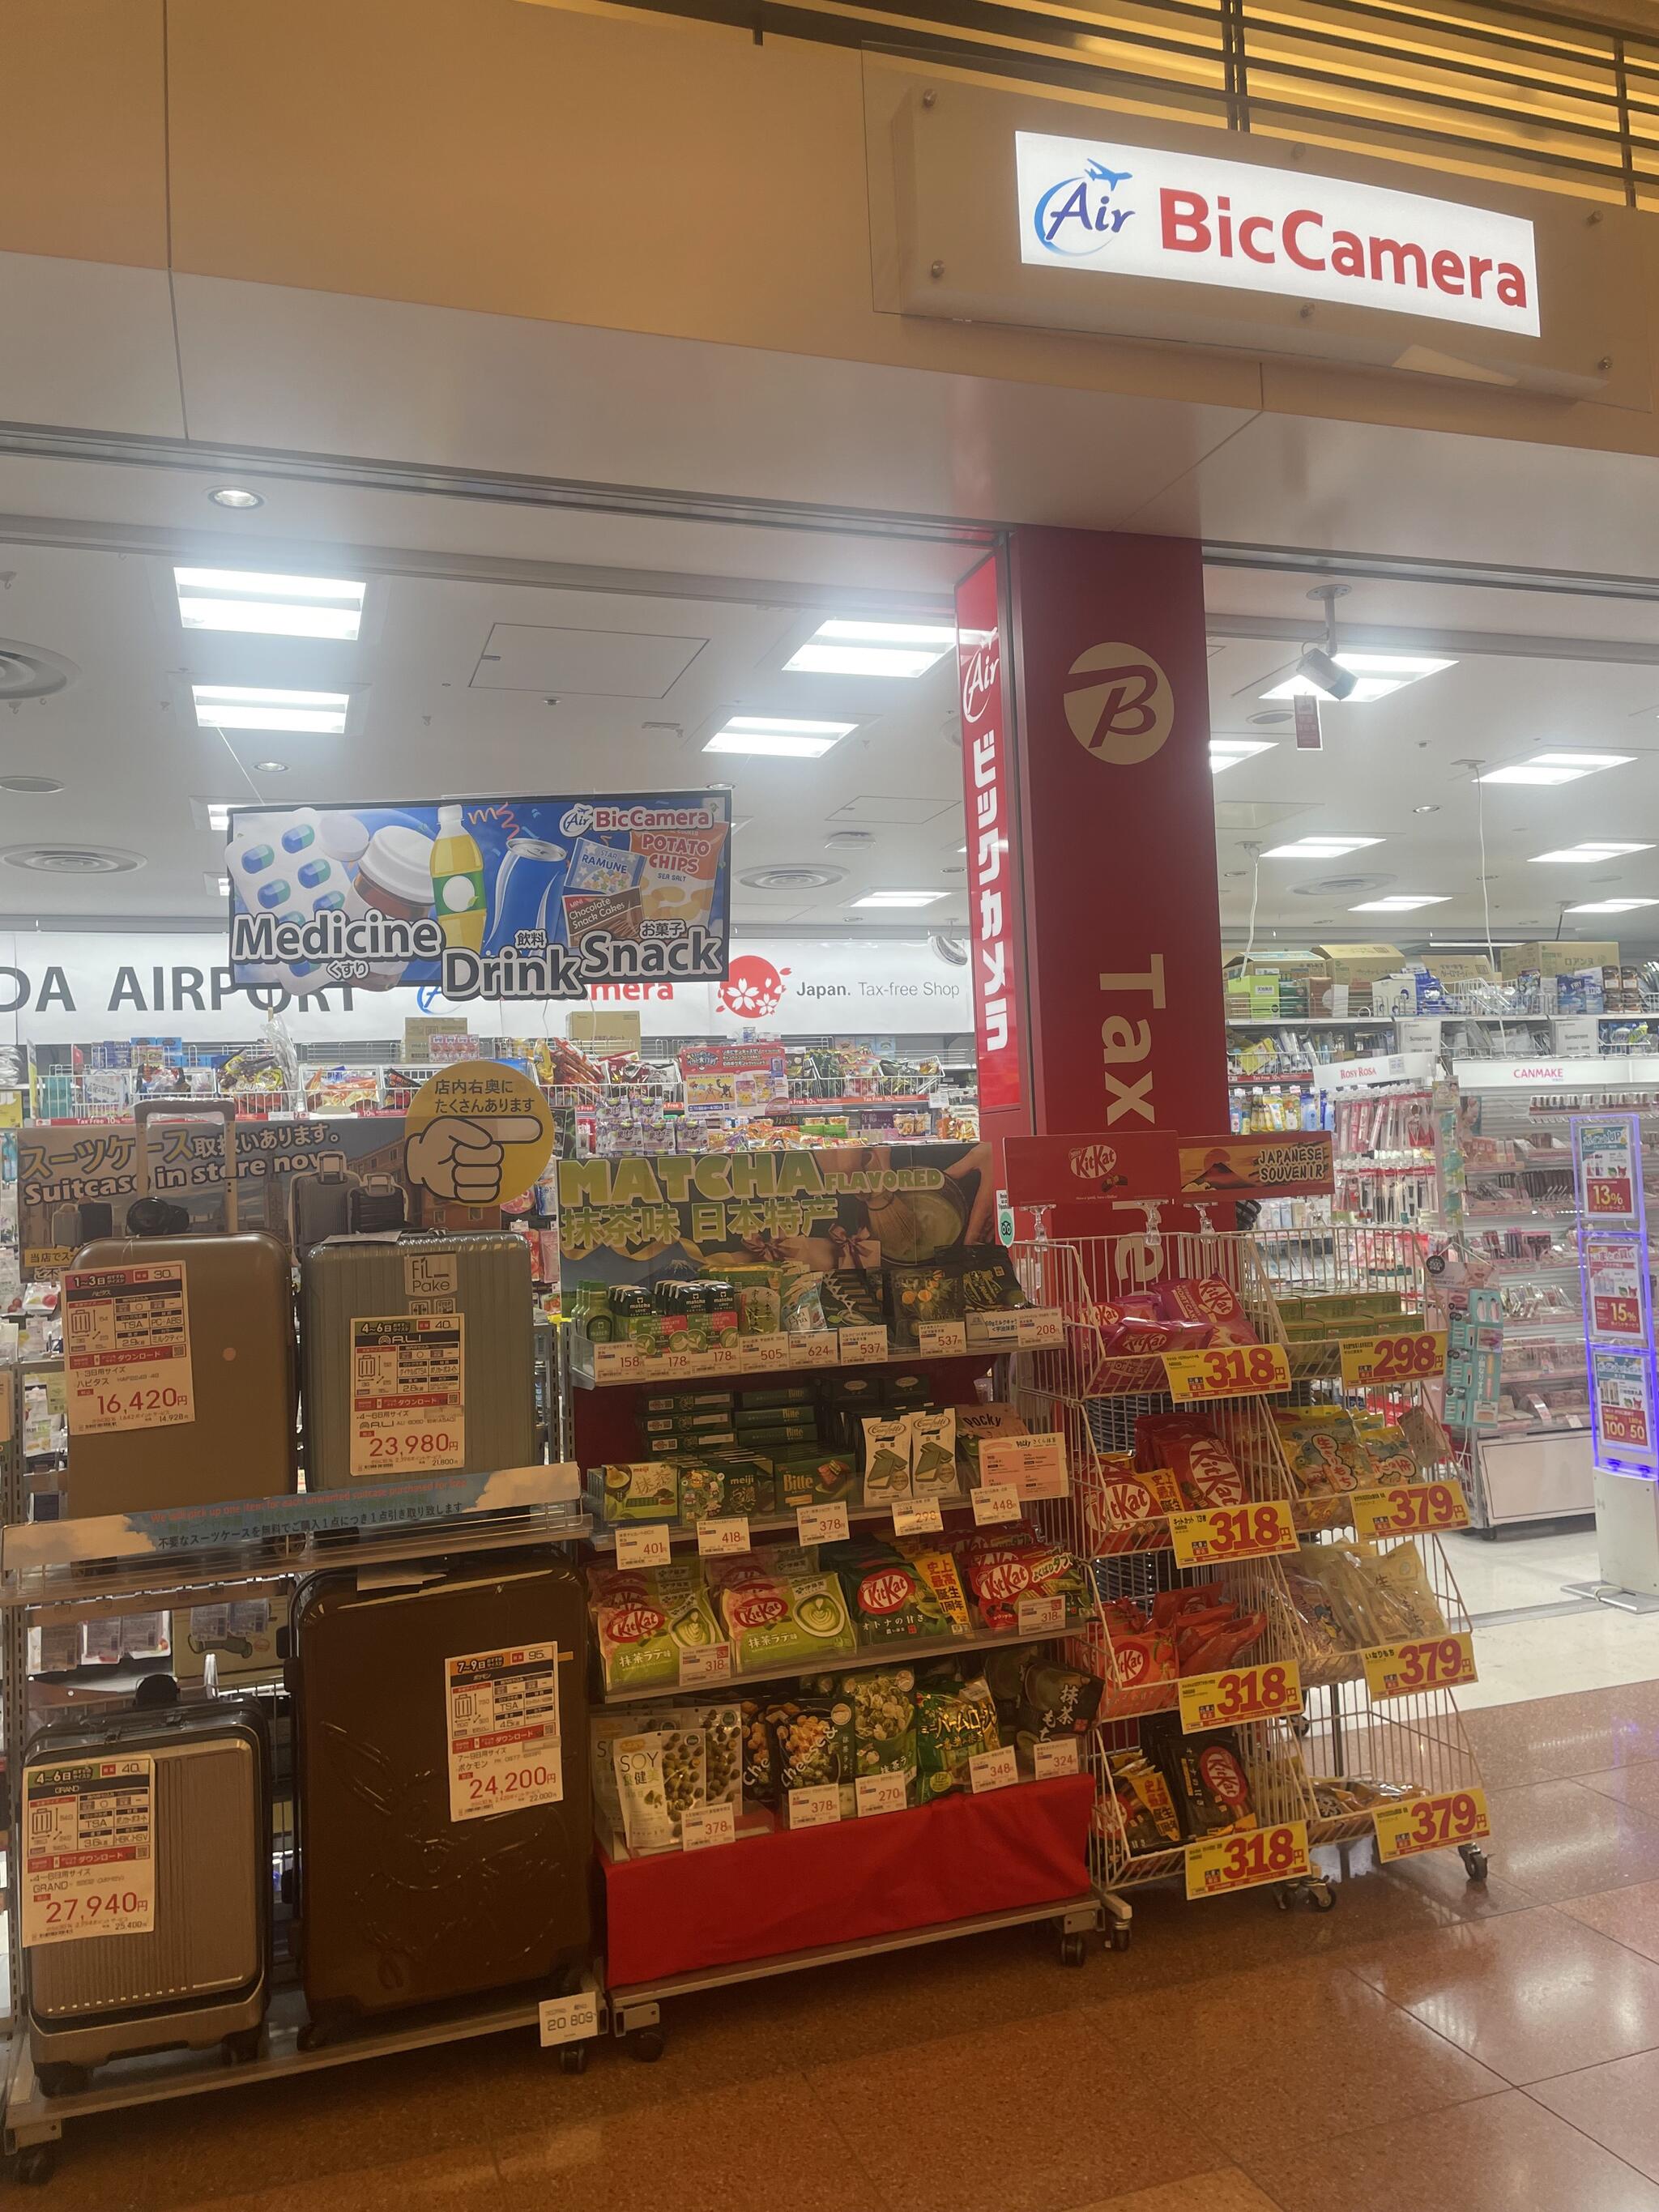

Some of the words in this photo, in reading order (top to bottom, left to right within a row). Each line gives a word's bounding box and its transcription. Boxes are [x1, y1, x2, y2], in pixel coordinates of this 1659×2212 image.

[1044, 182, 1136, 242] Air
[1160, 187, 1528, 309] BicCamera
[567, 812, 589, 829] Air
[596, 810, 709, 828] BicCamera
[600, 850, 617, 859] STAR
[642, 834, 710, 855] POTATO
[582, 854, 627, 874] RAMUNE
[649, 854, 699, 873] CHIPS
[657, 872, 671, 880] SEA
[671, 874, 686, 882] SALT
[973, 731, 1009, 1052] ビックカメラ
[569, 899, 583, 909] MINI
[569, 898, 612, 920] Chocolate
[572, 914, 598, 930] Snack
[599, 901, 625, 918] Cakes
[237, 913, 441, 959] Medicine
[517, 930, 547, 947] 飲料
[642, 922, 684, 938] お菓子
[583, 928, 719, 976] Snack
[326, 961, 369, 978] くすり
[445, 944, 583, 996] Drink
[796, 982, 851, 999] Japan.
[858, 982, 919, 996] Tax-free
[923, 981, 961, 999] Shop
[1098, 953, 1166, 1126] Tax
[1513, 1068, 1564, 1078] CANMAKE
[434, 1078, 514, 1094] 店内右奥に
[434, 1097, 535, 1114] たくさんあります
[1076, 1145, 1115, 1178] KitKat
[1260, 1148, 1323, 1165] JAPANESE
[156, 1166, 186, 1189] in
[559, 1151, 825, 1207] MATCHA
[825, 1169, 945, 1193] FLAVORED
[1260, 1164, 1325, 1183] SOUVENIR
[1593, 1185, 1623, 1205] 13%
[561, 1200, 680, 1248] 抹茶味
[692, 1196, 839, 1242] 日本特产
[412, 1280, 450, 1293] Pake
[1199, 1280, 1232, 1314] KitKat
[1610, 1302, 1636, 1322] 15%
[122, 1321, 143, 1329] TSA
[117, 1351, 160, 1362] ダウンロード
[1373, 1335, 1444, 1376] 298円
[1204, 1347, 1286, 1389] 318円
[77, 1378, 109, 1387] ハピタス
[97, 1387, 188, 1415] 16,420円
[398, 1399, 438, 1407] ダウンロード
[1605, 1421, 1625, 1437] 100
[1630, 1425, 1644, 1439] 50
[369, 1433, 458, 1457] 23,980円
[1016, 1439, 1031, 1448] Pocky
[730, 1475, 754, 1485] meiji
[783, 1474, 814, 1492] Bitte
[1191, 1447, 1242, 1507] KitKat
[151, 1514, 165, 1524] We
[209, 1508, 221, 1517] up
[224, 1506, 241, 1515] one
[267, 1499, 279, 1510] for
[306, 1491, 351, 1504] unwanted
[352, 1488, 388, 1499] suitcase
[389, 1481, 434, 1497] purchased
[1388, 1485, 1466, 1528] 379円
[1209, 1506, 1291, 1553] 318円
[928, 1560, 953, 1575] 史上
[931, 1573, 957, 1588] 最高
[985, 1564, 1029, 1600] KitKat
[868, 1575, 908, 1608] KitKat
[744, 1602, 783, 1624] KitKat
[862, 1613, 926, 1631] オトナの甘さ
[616, 1609, 659, 1639] KitKat
[748, 1632, 798, 1649] 抹茶ラテ味
[619, 1648, 672, 1667] 抹茶ラテ味
[1365, 1649, 1395, 1660] いなりもち
[1398, 1639, 1473, 1685] 379円
[1217, 1667, 1298, 1715] 318円
[500, 1702, 519, 1711] TSA
[1056, 1685, 1079, 1725] 抹茶
[1039, 1710, 1056, 1741] もち
[495, 1730, 533, 1742] ダウンロード
[458, 1761, 488, 1772] ポケモン
[620, 1750, 659, 1773] SOY
[470, 1767, 557, 1800] 24,200円
[1207, 1756, 1240, 1797] KitKat
[55, 1785, 79, 1794] GRAND
[84, 1819, 108, 1829] TSA
[1411, 1793, 1487, 1843] 379円
[78, 1852, 124, 1864] ダウンロード
[1223, 1828, 1305, 1879] 318円
[46, 1891, 148, 1924] 27,940円
